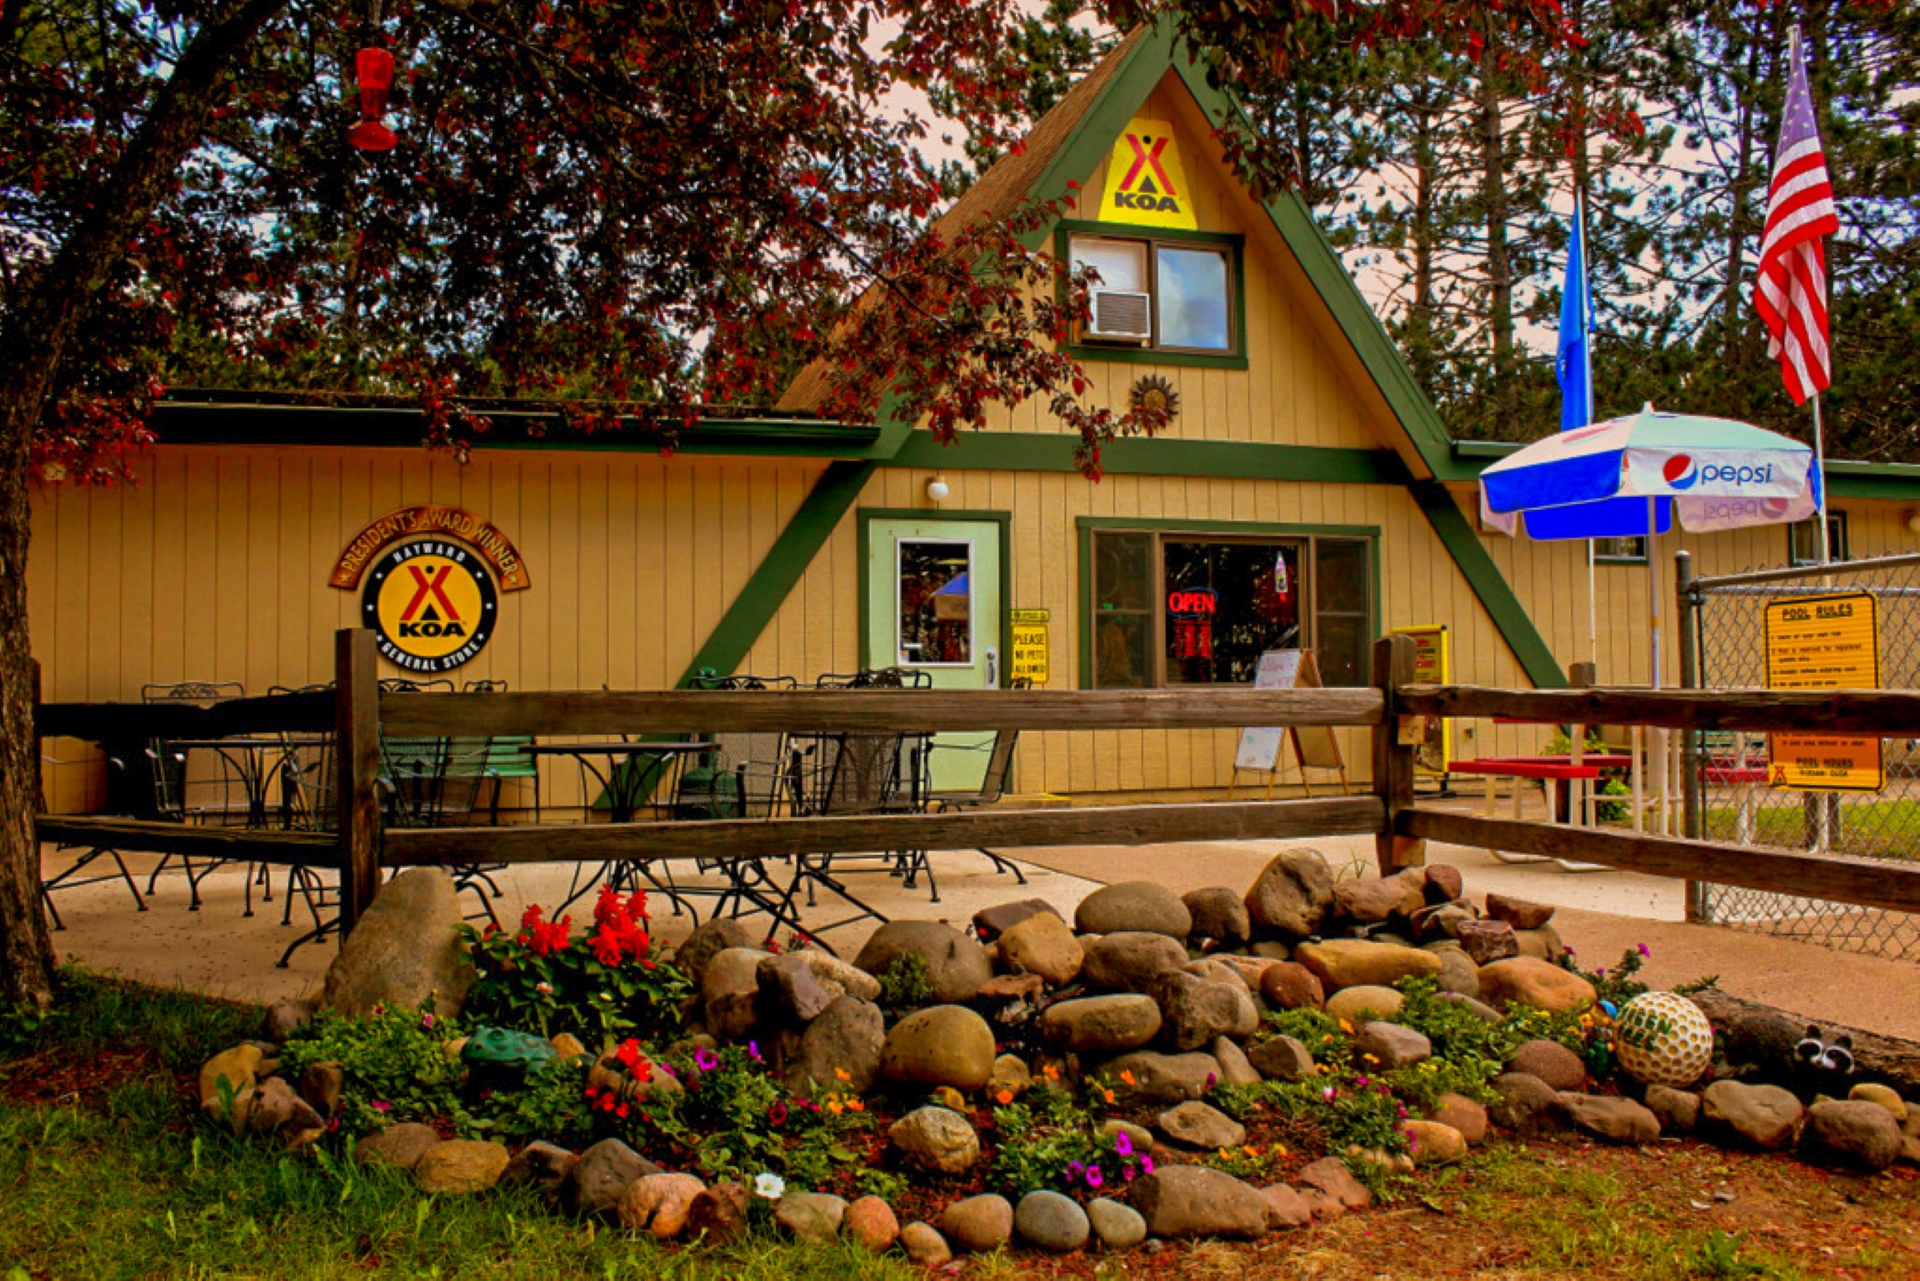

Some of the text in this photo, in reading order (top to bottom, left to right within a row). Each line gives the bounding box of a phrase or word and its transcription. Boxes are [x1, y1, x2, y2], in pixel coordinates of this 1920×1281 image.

[1115, 192, 1181, 213] KOA
[1701, 463, 1773, 487] pepsi
[342, 509, 519, 577] PRESIDENT'S AWARD WINNER
[392, 542, 466, 563] HAYWARD
[1168, 592, 1216, 613] OPEN
[1782, 603, 1853, 620] POOL RULES
[398, 622, 467, 637] KOA
[1014, 633, 1044, 645] PLEASE
[381, 641, 481, 671] GENERAL STORE
[1015, 650, 1044, 660] NO PETS
[1796, 757, 1854, 768] POOL HOURS
